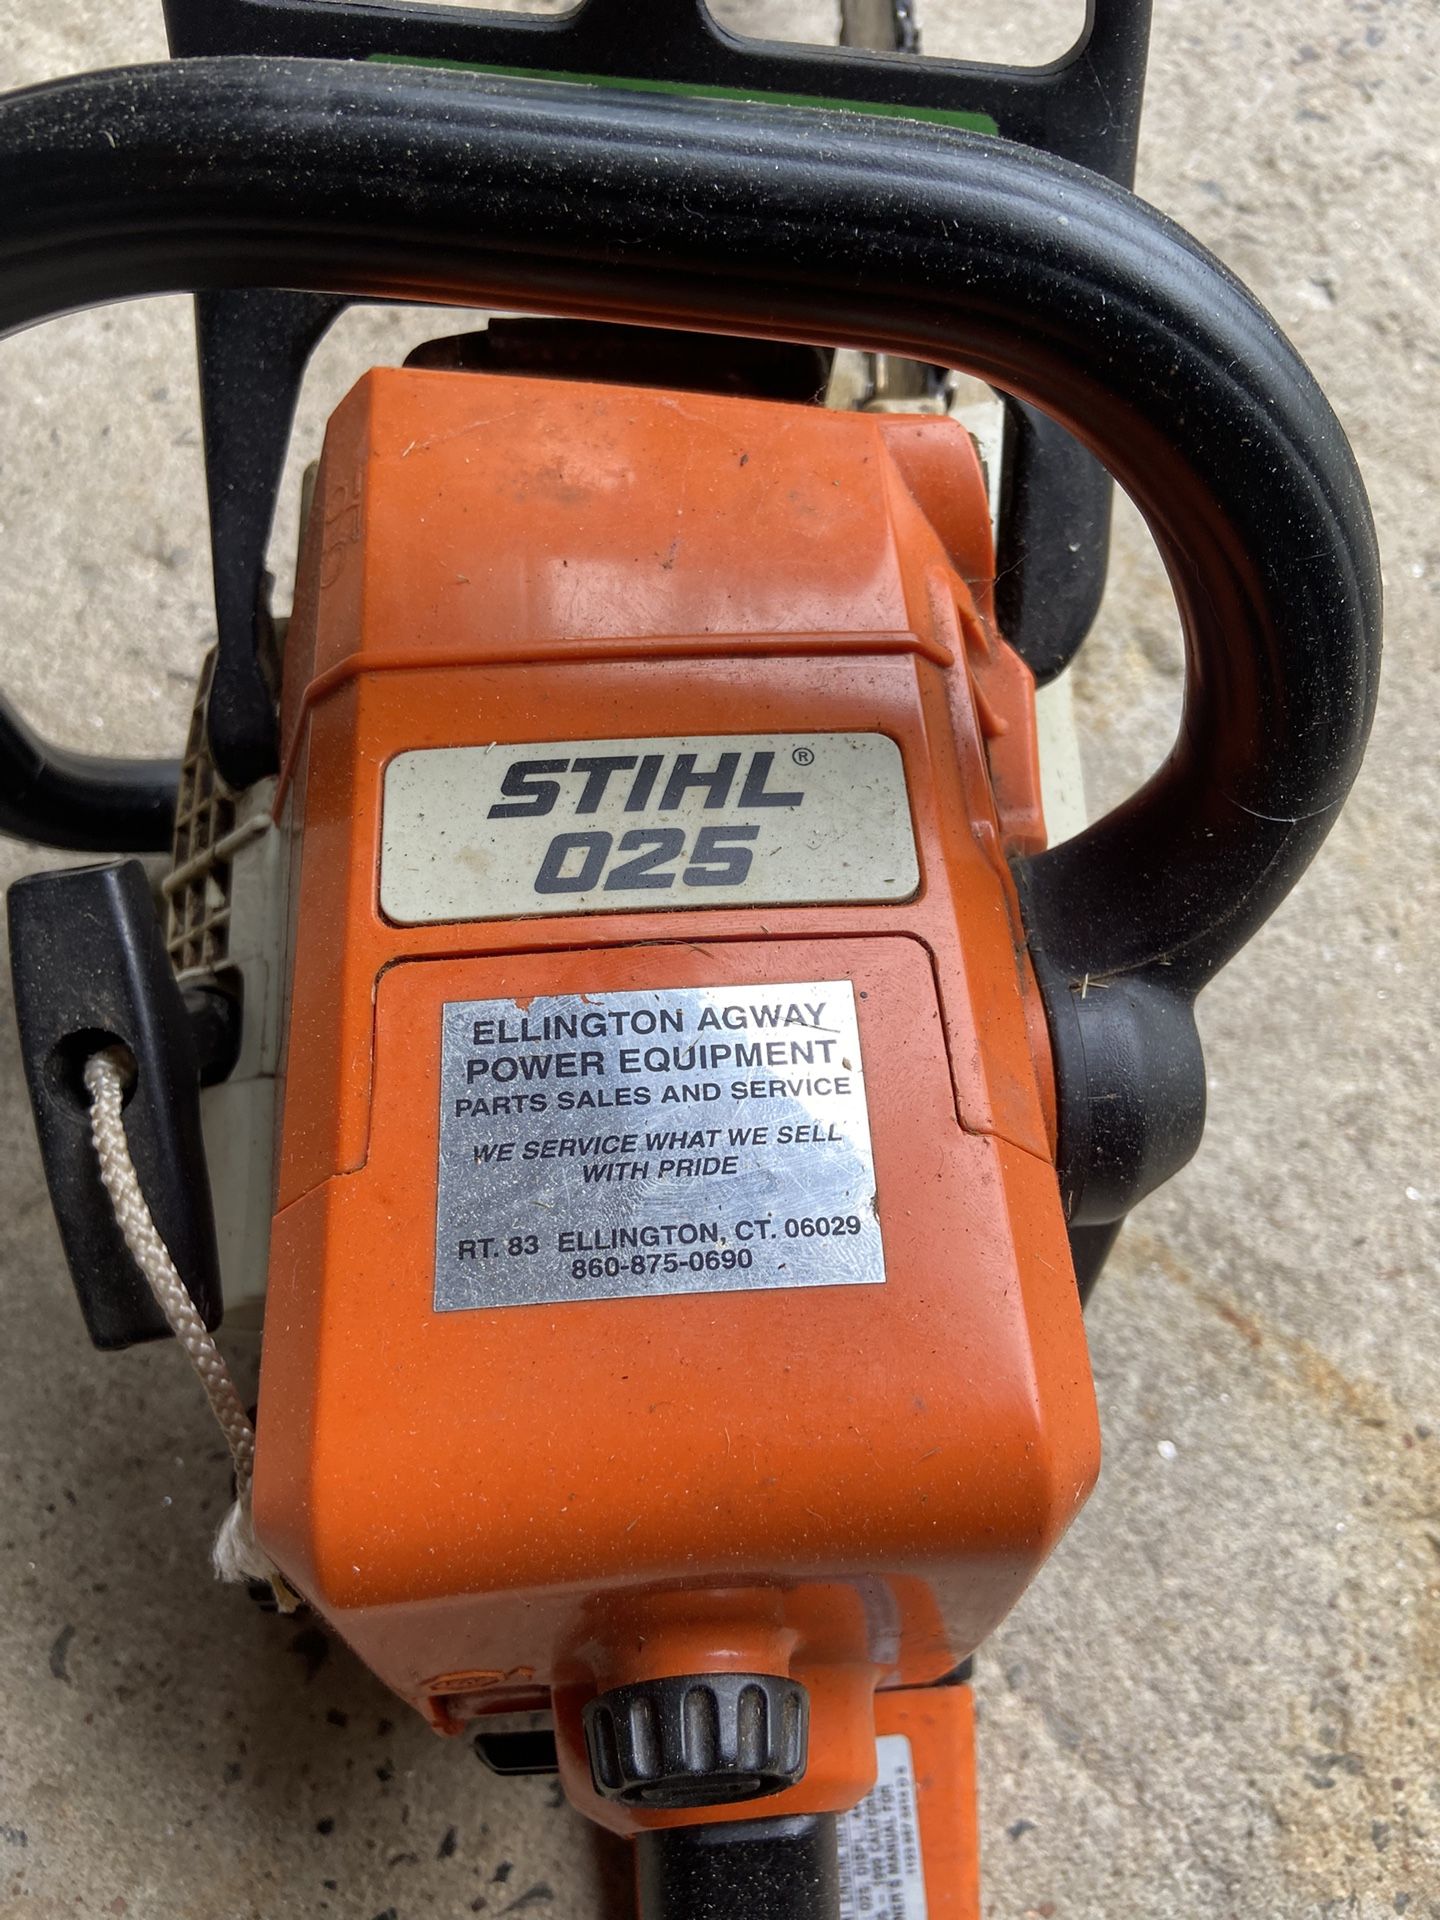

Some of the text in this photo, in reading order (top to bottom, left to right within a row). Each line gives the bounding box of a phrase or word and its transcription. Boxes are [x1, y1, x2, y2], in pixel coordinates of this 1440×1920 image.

[534, 825, 760, 894] 025
[473, 1002, 826, 1046] ELLINGTON AGWAY
[466, 1039, 837, 1084] POWER EQUIPMENT
[455, 1077, 851, 1118] PARTS SALES AND SERVICE
[473, 1124, 842, 1163] WE SERVICE WHAT WE SELL
[583, 1156, 739, 1183] WITH PRIDE
[458, 1215, 861, 1260] RT. 83 ELLINGTON, CT. 06029
[571, 1249, 753, 1279] 860-875-0690
